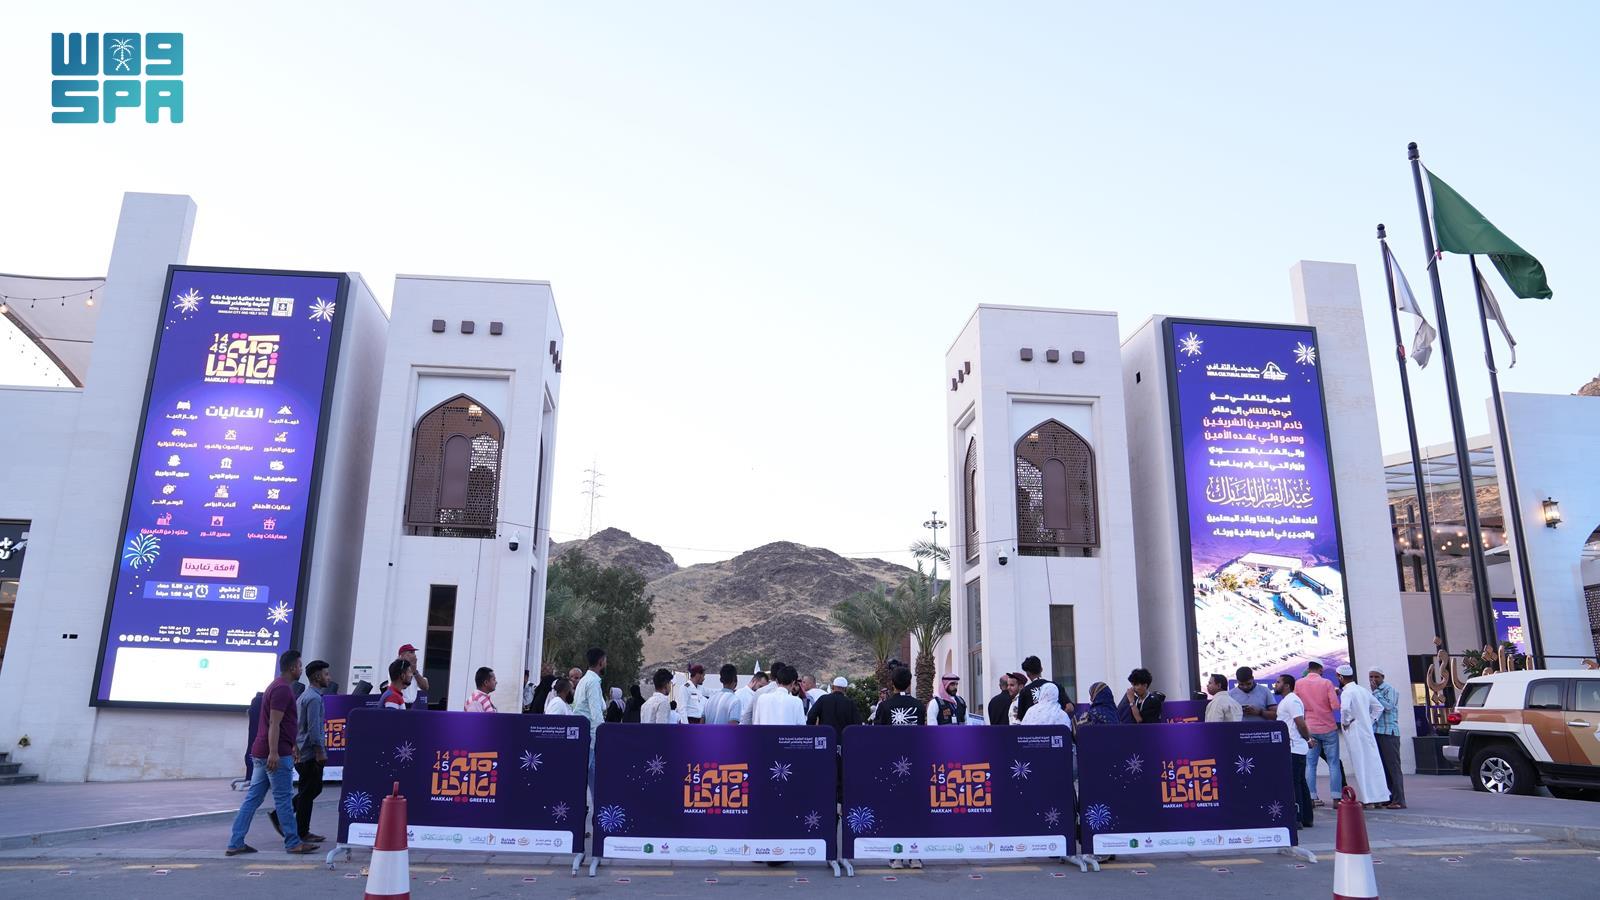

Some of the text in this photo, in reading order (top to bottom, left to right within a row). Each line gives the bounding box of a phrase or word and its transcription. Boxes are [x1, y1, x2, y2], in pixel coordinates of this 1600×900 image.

[214, 333, 228, 344] 14
[210, 343, 228, 353] 45
[205, 405, 264, 419] الفعاليات
[1203, 417, 1303, 430] خادم الحرمين الشريفين
[1204, 430, 1232, 440] الأمين
[1258, 433, 1278, 444] ولي
[1280, 435, 1304, 444] وسمو
[184, 562, 236, 572] #مكة_تعايدنا
[436, 750, 450, 760] 14
[433, 761, 449, 771] 45
[687, 763, 700, 773] 14
[932, 764, 945, 773] 14
[1162, 760, 1174, 769] 14
[684, 774, 700, 784] 45
[930, 774, 945, 784] 45
[1161, 770, 1176, 780] 45
